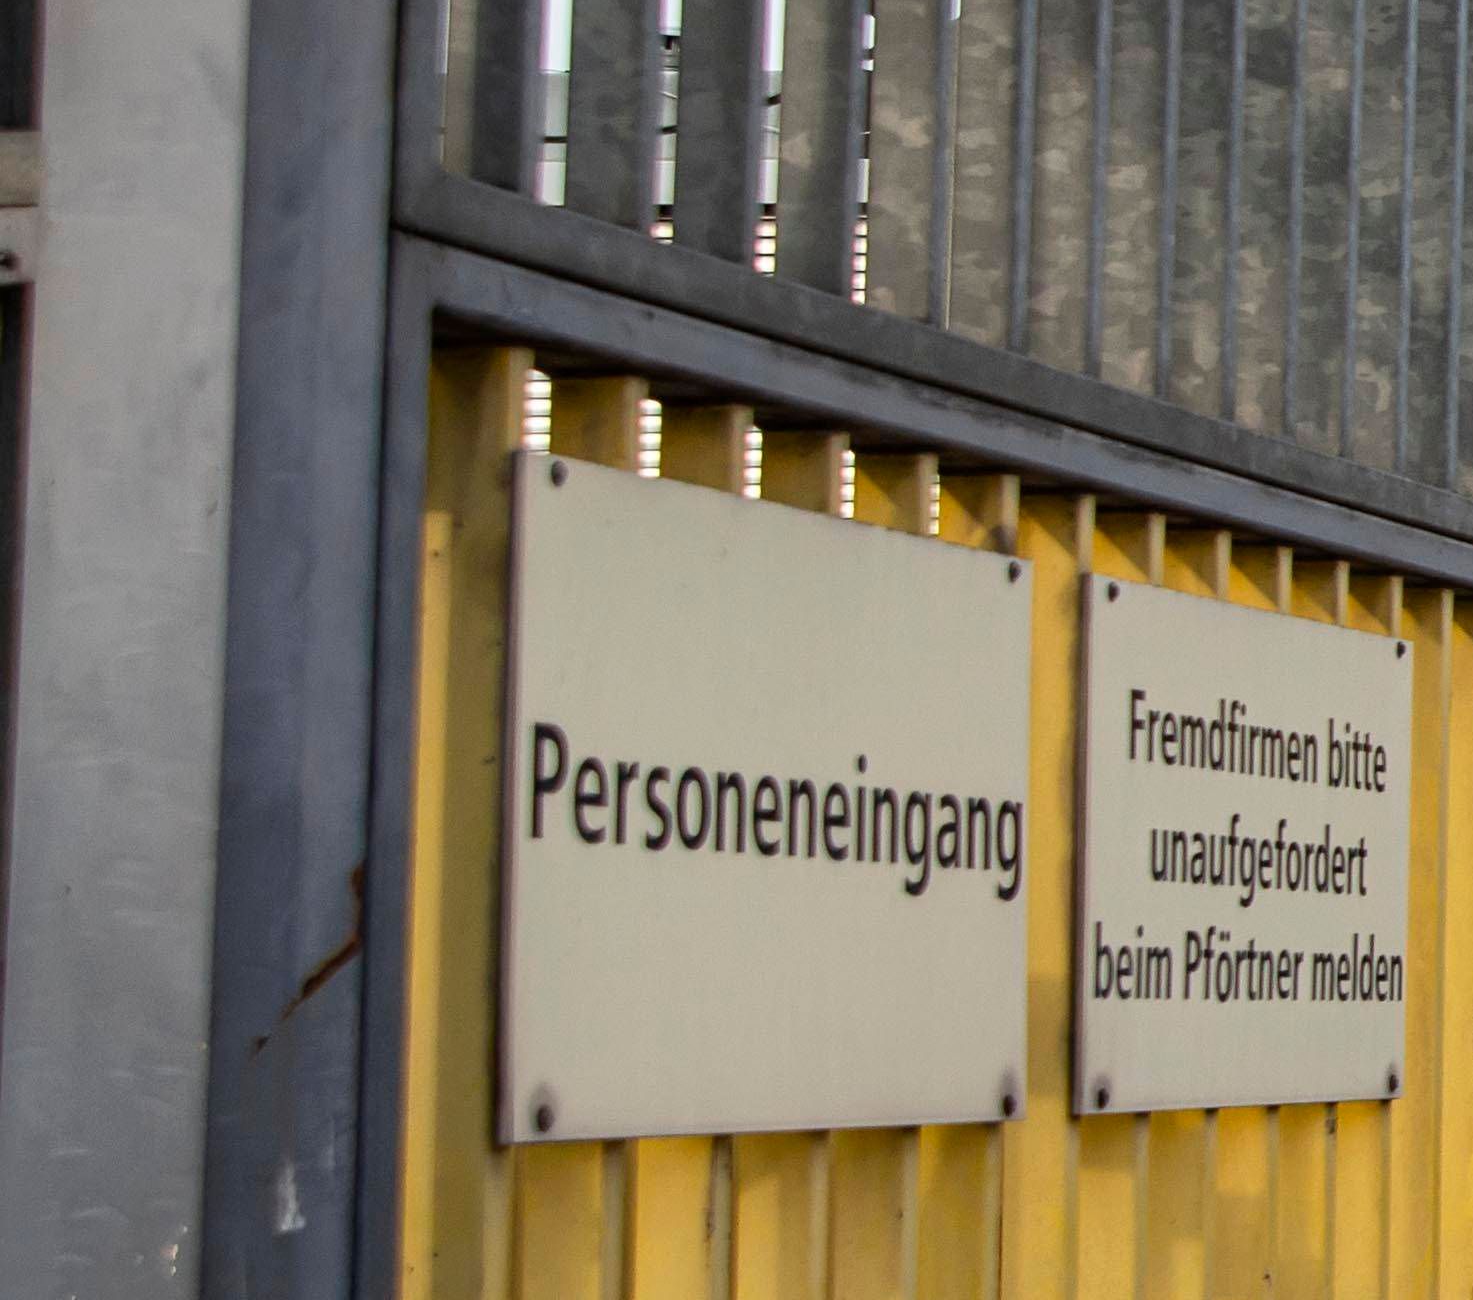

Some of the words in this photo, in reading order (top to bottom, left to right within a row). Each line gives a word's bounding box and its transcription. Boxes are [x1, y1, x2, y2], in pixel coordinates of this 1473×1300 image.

[1127, 688, 1319, 785] Fremdfirmen
[1325, 716, 1388, 794] bitte
[529, 720, 1024, 901] Personeneingang
[1150, 813, 1369, 908] unaufgefordert
[1091, 922, 1174, 1002] beim
[1182, 930, 1305, 1004] Pförtner
[1311, 933, 1405, 1004] melden
